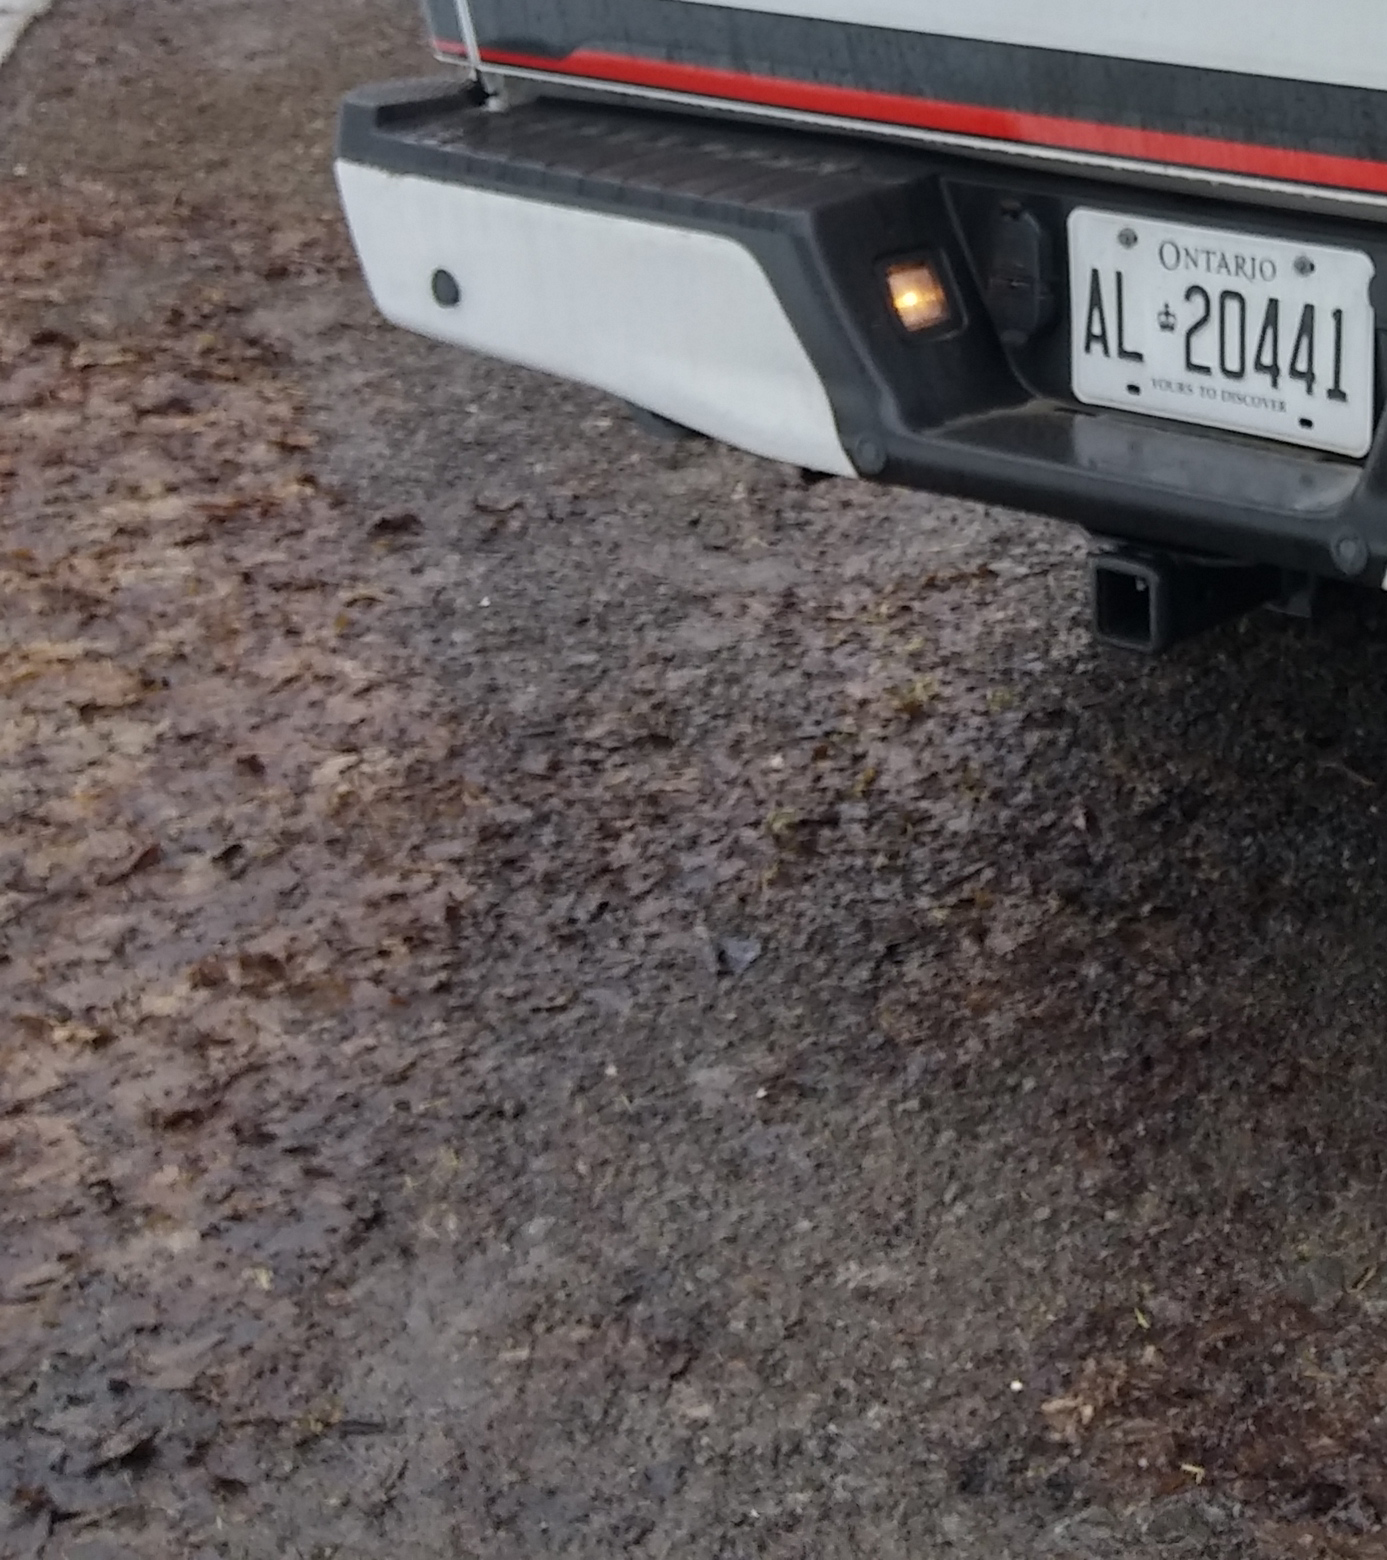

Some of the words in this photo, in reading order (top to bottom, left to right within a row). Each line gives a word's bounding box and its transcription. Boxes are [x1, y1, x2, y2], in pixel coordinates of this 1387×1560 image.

[1158, 240, 1278, 283] ONTARIO
[1084, 267, 1145, 363] AL
[1184, 284, 1348, 403] 20441
[1199, 384, 1217, 400] TO
[1220, 389, 1287, 413] DISCOVER
